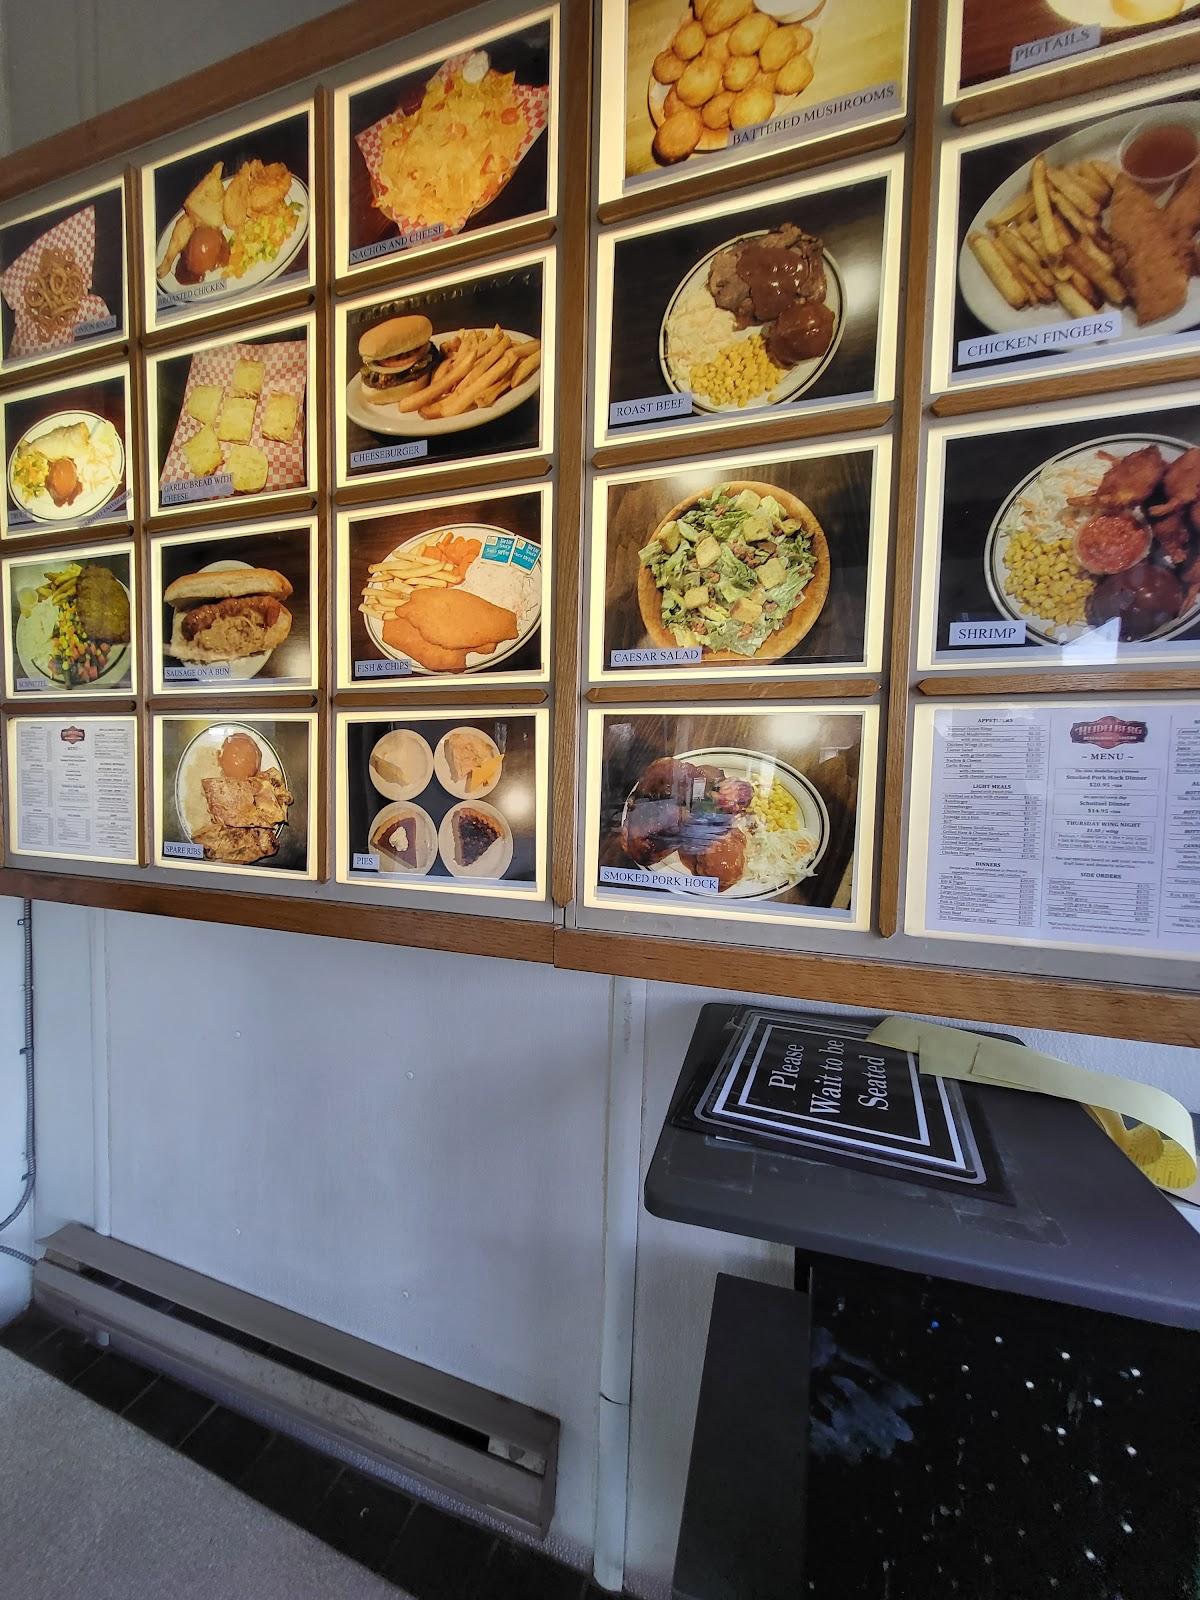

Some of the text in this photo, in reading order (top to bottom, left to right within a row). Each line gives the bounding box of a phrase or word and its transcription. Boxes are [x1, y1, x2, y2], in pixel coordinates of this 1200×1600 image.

[732, 84, 895, 146] BATTERED MUSHROOMS
[351, 225, 443, 260] NACHOS AND CHEESE
[193, 280, 225, 297] CHICKEN
[967, 320, 1114, 357] CHICKEN FINGERS
[616, 397, 685, 417] ROAST BEEF
[353, 445, 420, 463] CHEESEBURGER
[164, 474, 233, 493] GARLIC BREAD WITH
[164, 492, 189, 503] CHEESE
[958, 627, 1017, 640] SHRIMP
[614, 649, 699, 663] CAESAR SALAD
[166, 667, 230, 678] SAUSAGE ON A BUN
[357, 661, 409, 672] FISH & CHIPS
[165, 845, 202, 856] SPARE RIBS
[356, 856, 374, 866] PIES
[603, 870, 717, 889] SMOKED PORK HOCK
[767, 1043, 805, 1092] Please
[809, 1038, 845, 1116] Wait to be
[857, 1053, 889, 1112] Seated
